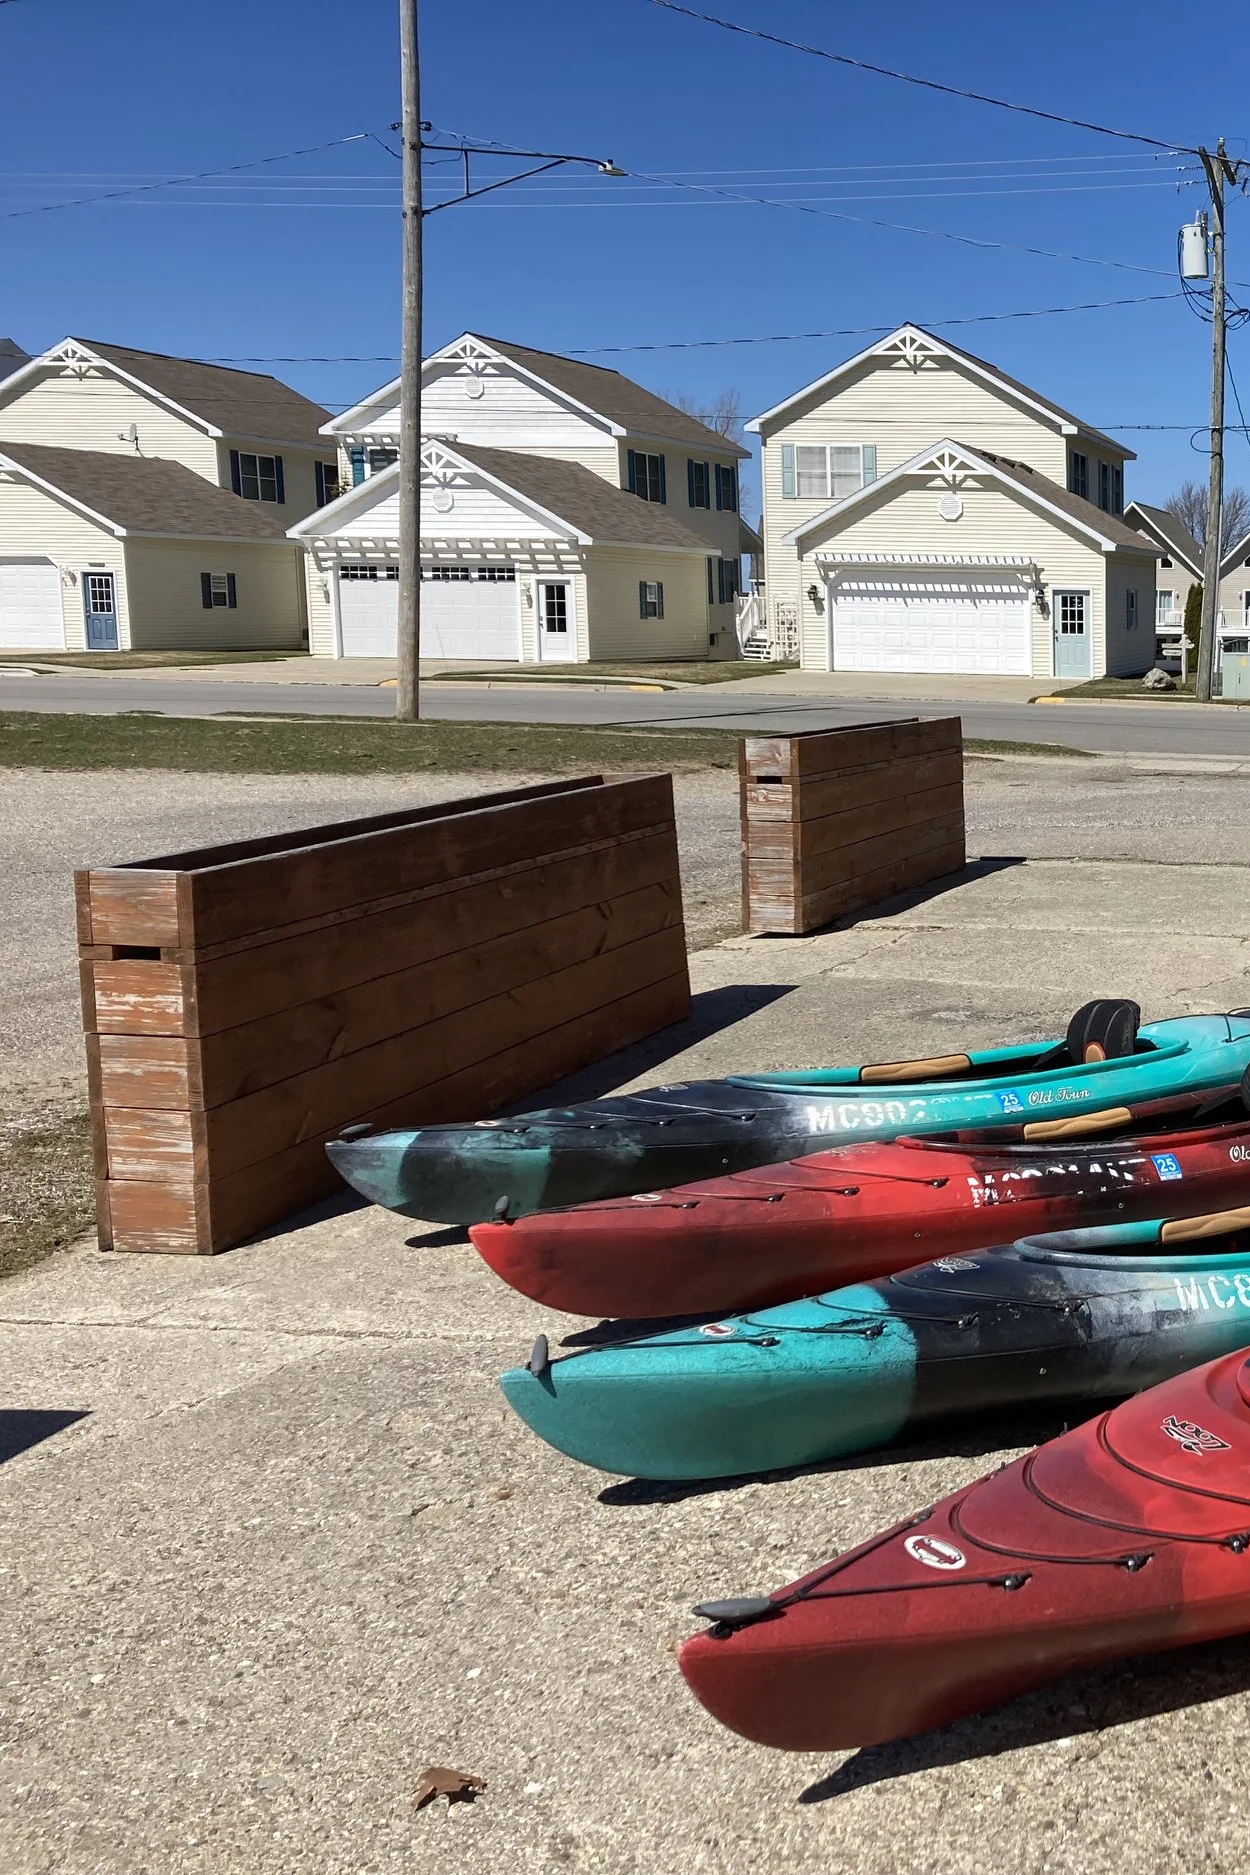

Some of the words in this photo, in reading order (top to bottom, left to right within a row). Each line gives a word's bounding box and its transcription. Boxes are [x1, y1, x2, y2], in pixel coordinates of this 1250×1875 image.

[1000, 1093, 1019, 1107] 25
[1028, 1090, 1054, 1105] Old
[1055, 1086, 1091, 1102] Town
[1156, 1157, 1177, 1172] 25
